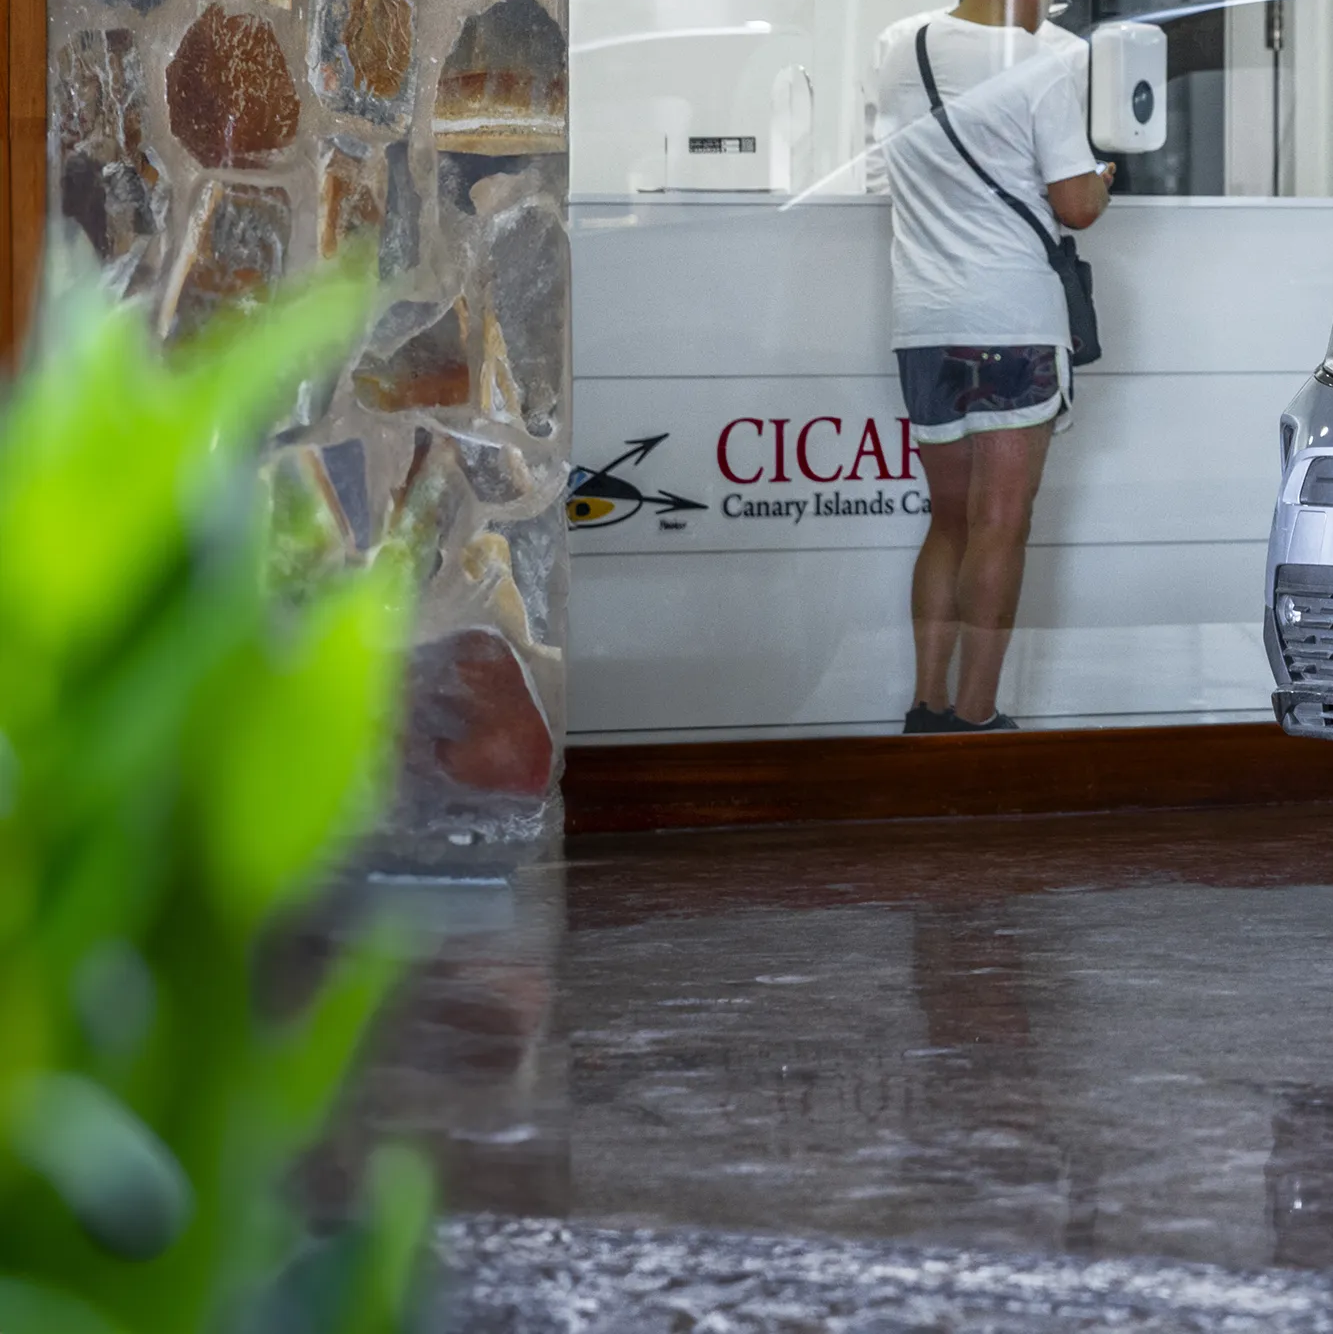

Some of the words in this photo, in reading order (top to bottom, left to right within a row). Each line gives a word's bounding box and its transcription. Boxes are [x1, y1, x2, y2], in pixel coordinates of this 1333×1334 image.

[722, 493, 808, 524] Canary
[814, 490, 894, 516] Islands
[902, 491, 932, 515] Ca
